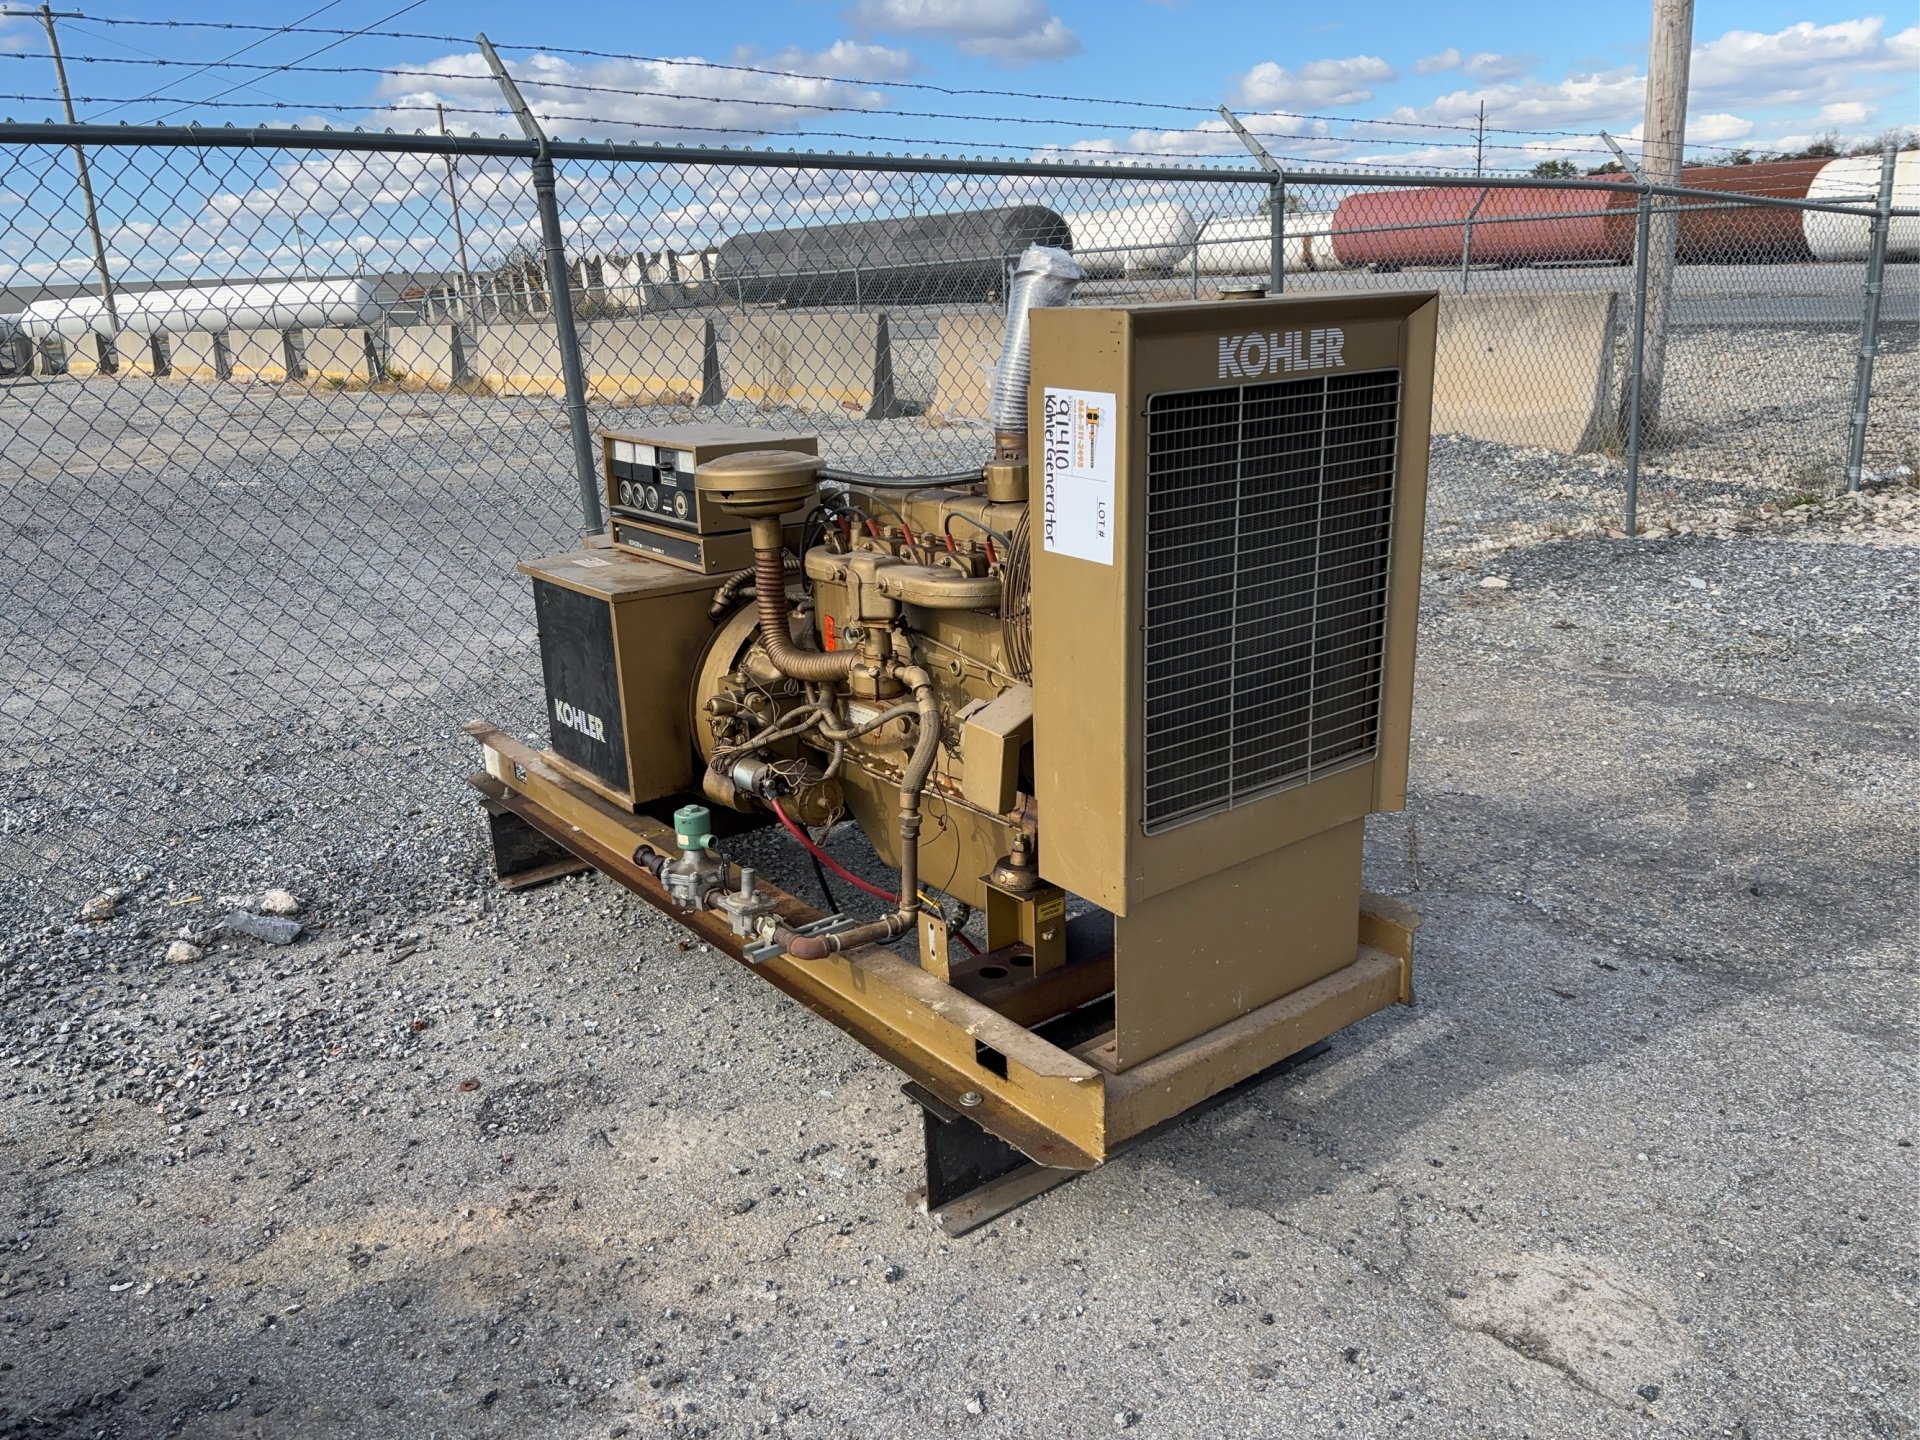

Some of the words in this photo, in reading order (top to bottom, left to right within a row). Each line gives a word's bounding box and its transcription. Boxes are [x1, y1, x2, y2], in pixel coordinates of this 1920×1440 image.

[1218, 327, 1346, 379] KOHLER
[1045, 395, 1056, 446] Kohler
[1055, 399, 1070, 469] 91410
[1045, 448, 1056, 547] Generator
[1098, 502, 1106, 527] LOT
[1098, 530, 1105, 538] #
[554, 698, 607, 743] KOHLER
